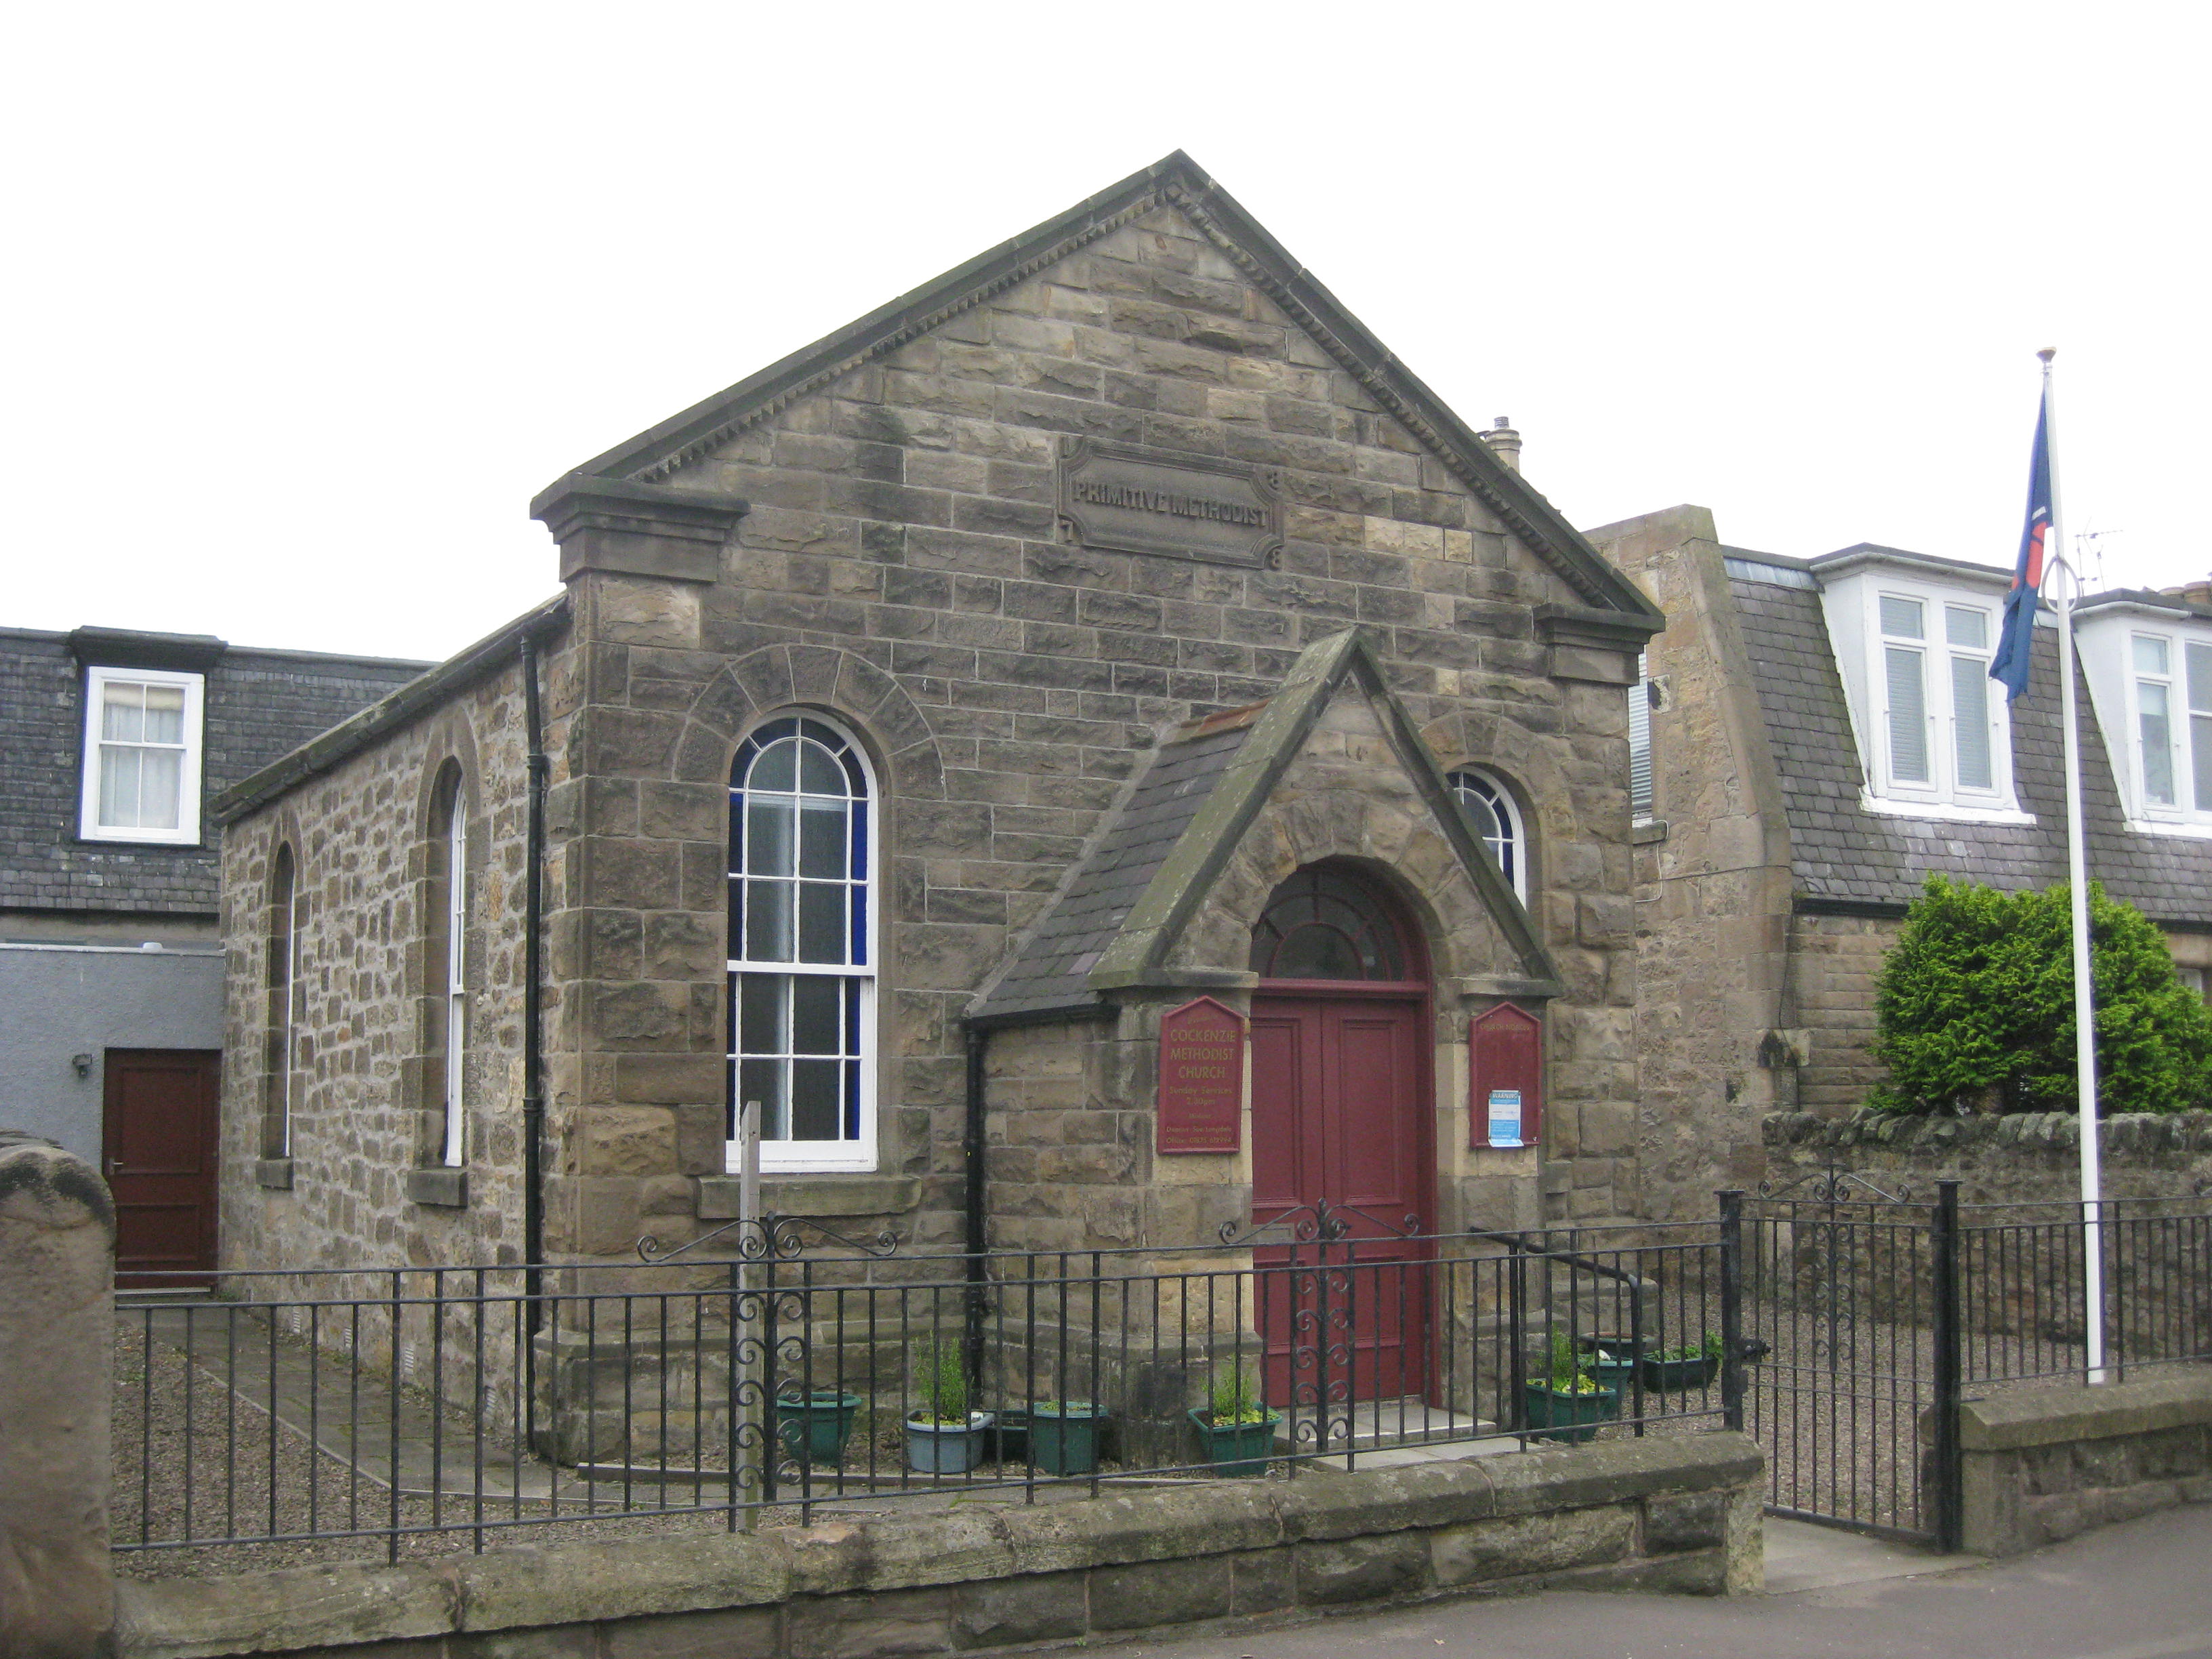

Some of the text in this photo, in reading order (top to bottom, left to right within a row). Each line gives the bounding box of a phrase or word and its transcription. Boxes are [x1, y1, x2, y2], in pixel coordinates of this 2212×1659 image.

[1073, 480, 1267, 527] PRIMITIVE METHODIST
[1170, 1029, 1236, 1042] COCKENZIE
[1170, 1048, 1235, 1061] METHODIST
[1179, 1066, 1226, 1079] CHURCH
